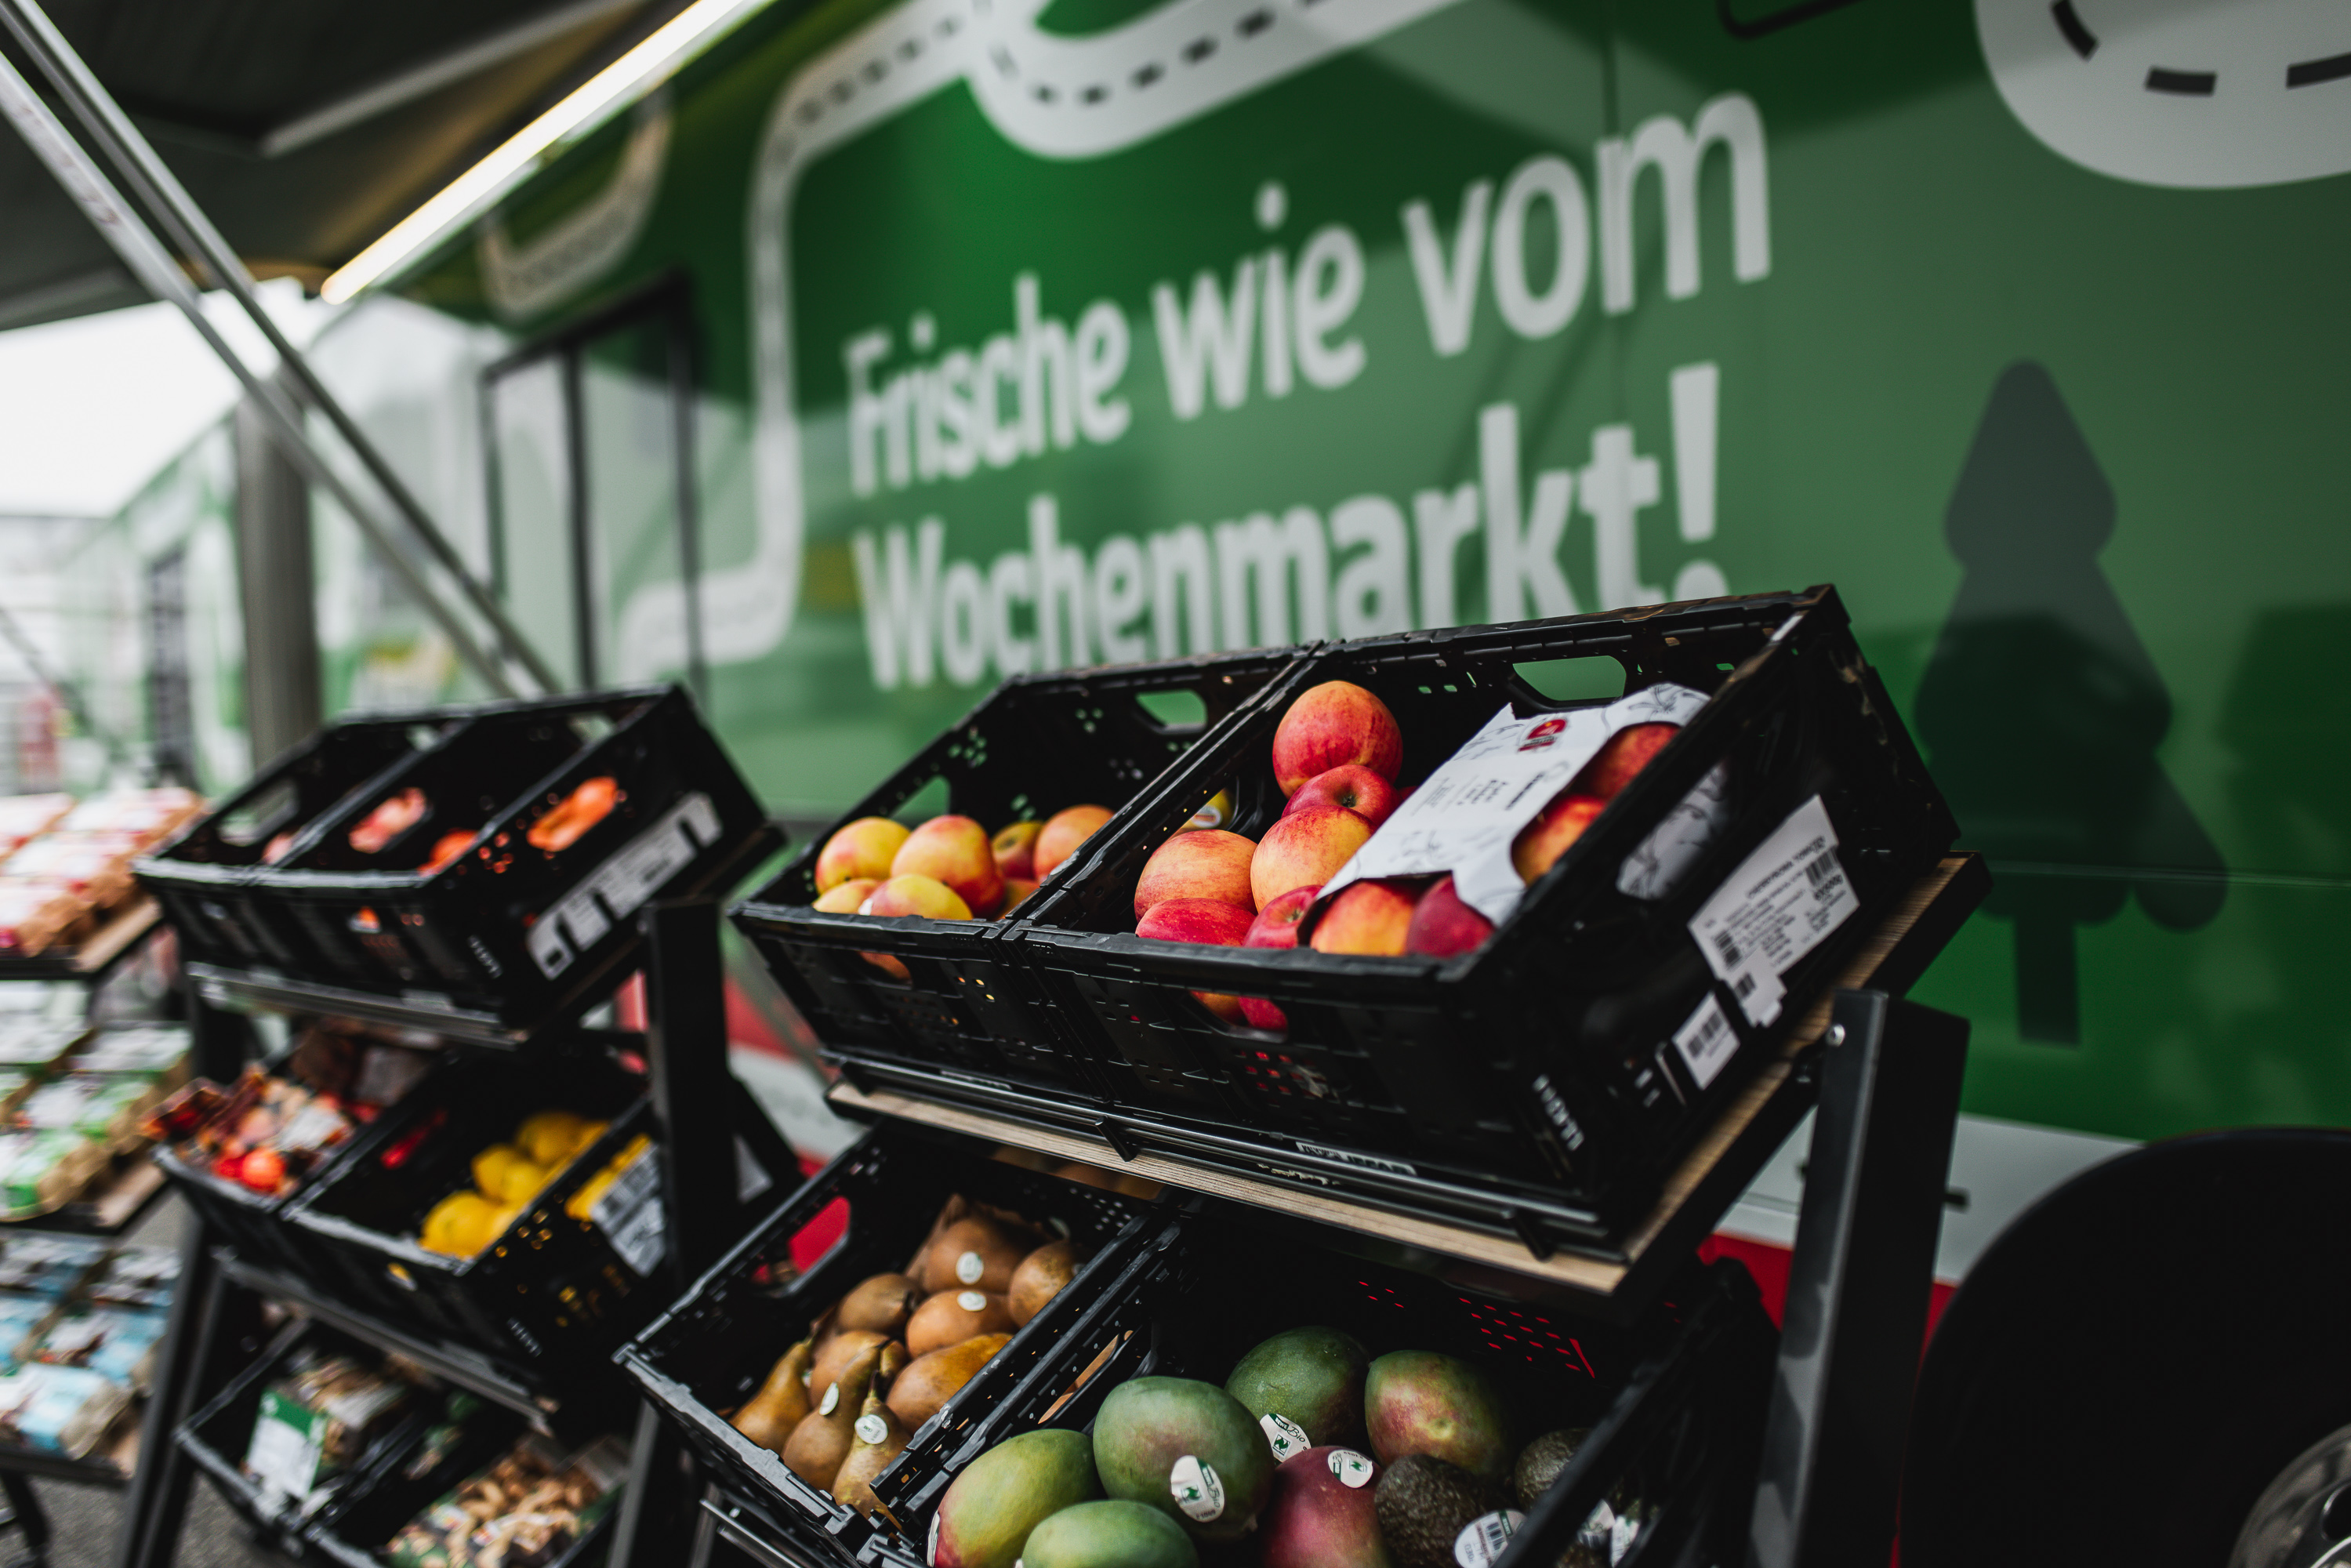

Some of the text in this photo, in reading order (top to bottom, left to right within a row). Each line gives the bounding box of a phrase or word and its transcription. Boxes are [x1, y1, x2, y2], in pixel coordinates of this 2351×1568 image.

[844, 93, 1771, 499] Frische wie vom
[851, 362, 1729, 691] Wochenmarkt!
[1208, 1487, 1221, 1508] Bio
[1286, 1426, 1306, 1443] Bio
